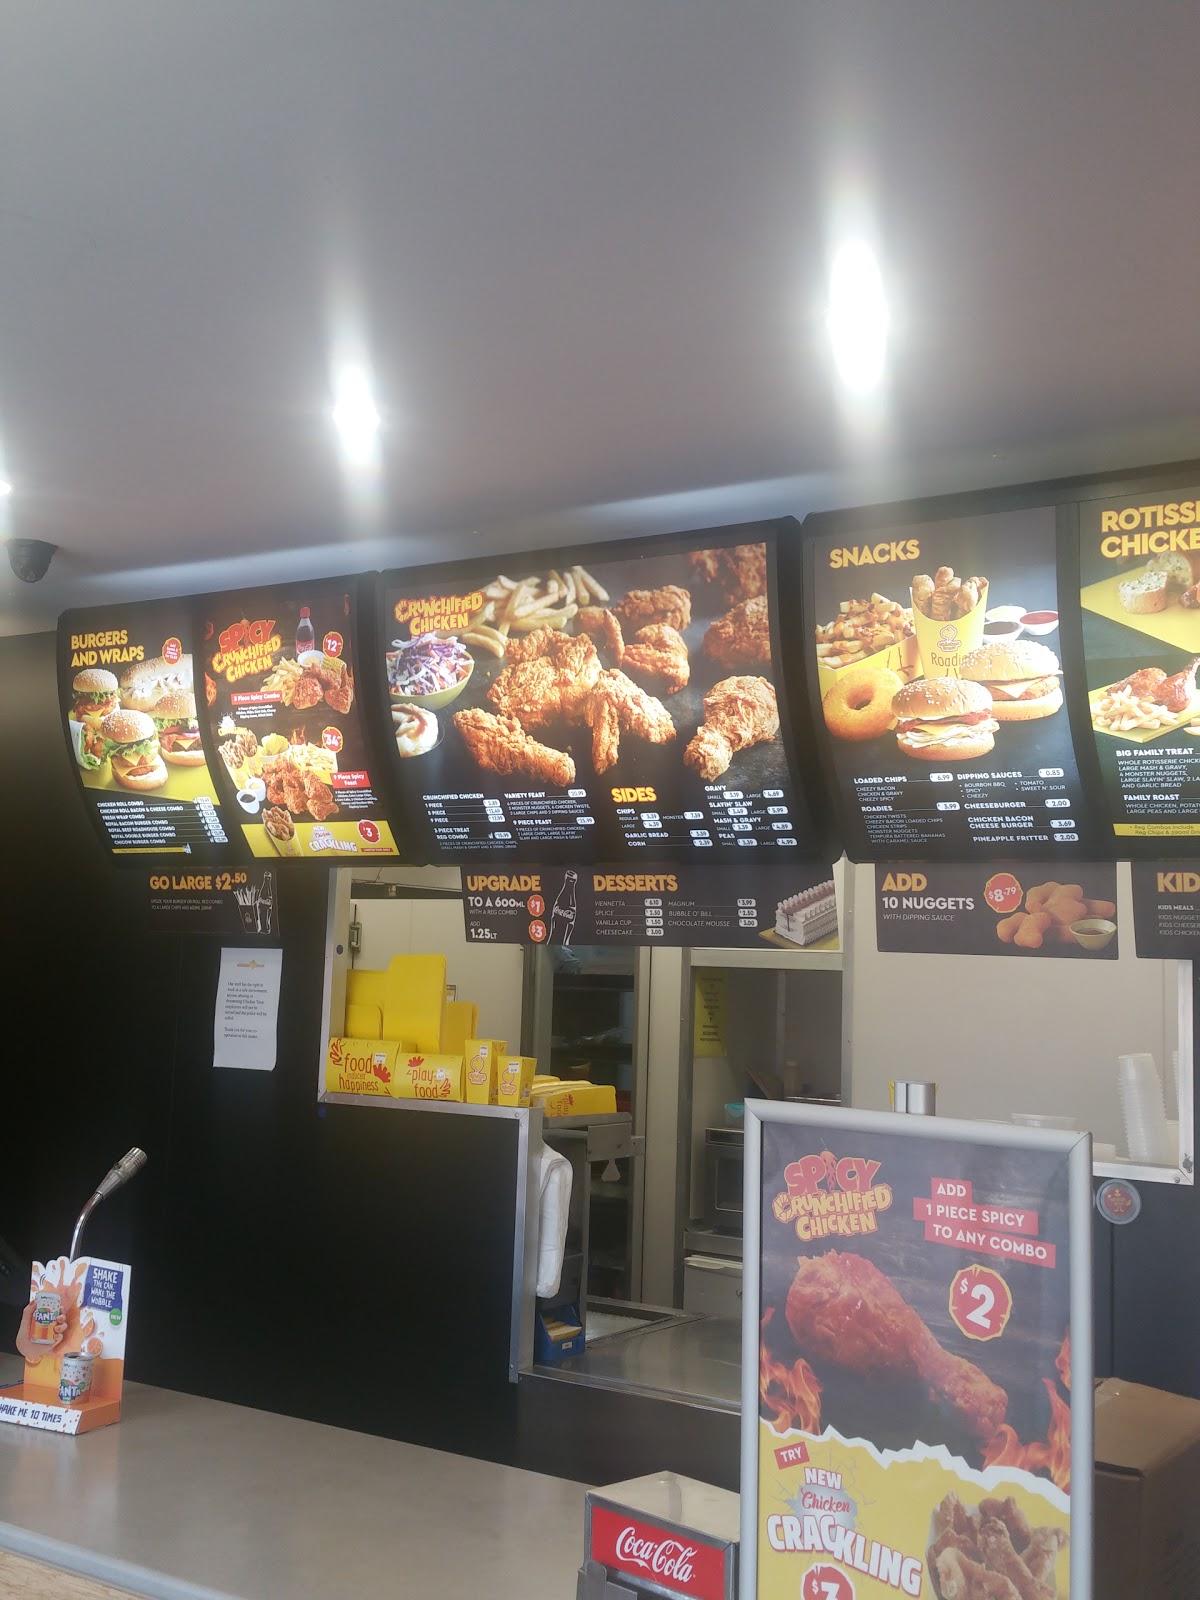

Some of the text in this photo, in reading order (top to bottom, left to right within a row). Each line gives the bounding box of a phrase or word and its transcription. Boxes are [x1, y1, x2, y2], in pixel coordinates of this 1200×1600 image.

[830, 539, 920, 568] SNACKS
[394, 592, 484, 622] CRUNCHIFIED
[410, 612, 469, 635] CHICKEN
[71, 629, 128, 650] BURGERS
[219, 619, 276, 655] SPICY
[71, 652, 98, 668] AND
[99, 645, 145, 665] WRAPS
[212, 634, 281, 672] CRUNCHIFIED
[226, 655, 273, 682] CHICKEN
[611, 786, 657, 803] SIDES
[150, 876, 170, 890] GO
[172, 876, 212, 890] LARGE
[467, 875, 541, 891] UPGRADE
[593, 875, 678, 892] DESSERTS
[882, 873, 927, 891] ADD
[468, 897, 525, 907] TO A 600ML
[882, 897, 975, 910] 10 NUGGETS
[471, 929, 498, 939] 1.25LT
[344, 1053, 372, 1073] food
[339, 1074, 379, 1092] happiness
[412, 1068, 434, 1084] play
[414, 1084, 439, 1098] food
[784, 1151, 881, 1195] SPICY
[937, 1183, 967, 1198] ADD
[772, 1184, 893, 1223] CRUNCHIFIED
[926, 1204, 1024, 1228] 1 PIECE SPICY
[795, 1213, 878, 1240] CHICKEN
[933, 1223, 1047, 1260] TO ANY COMBO
[93, 1268, 118, 1284] SHAKE
[93, 1280, 102, 1289] THE
[106, 1291, 115, 1300] THE
[960, 1278, 995, 1329] $2
[18, 1408, 28, 1417] ME
[31, 1410, 40, 1420] 10
[42, 1411, 62, 1423] TIMES
[780, 1447, 802, 1463] TRY
[804, 1467, 842, 1490] NEW
[801, 1487, 850, 1513] Chicken
[616, 1527, 698, 1583] Coca-Cola
[767, 1514, 923, 1597] CRACKLING
